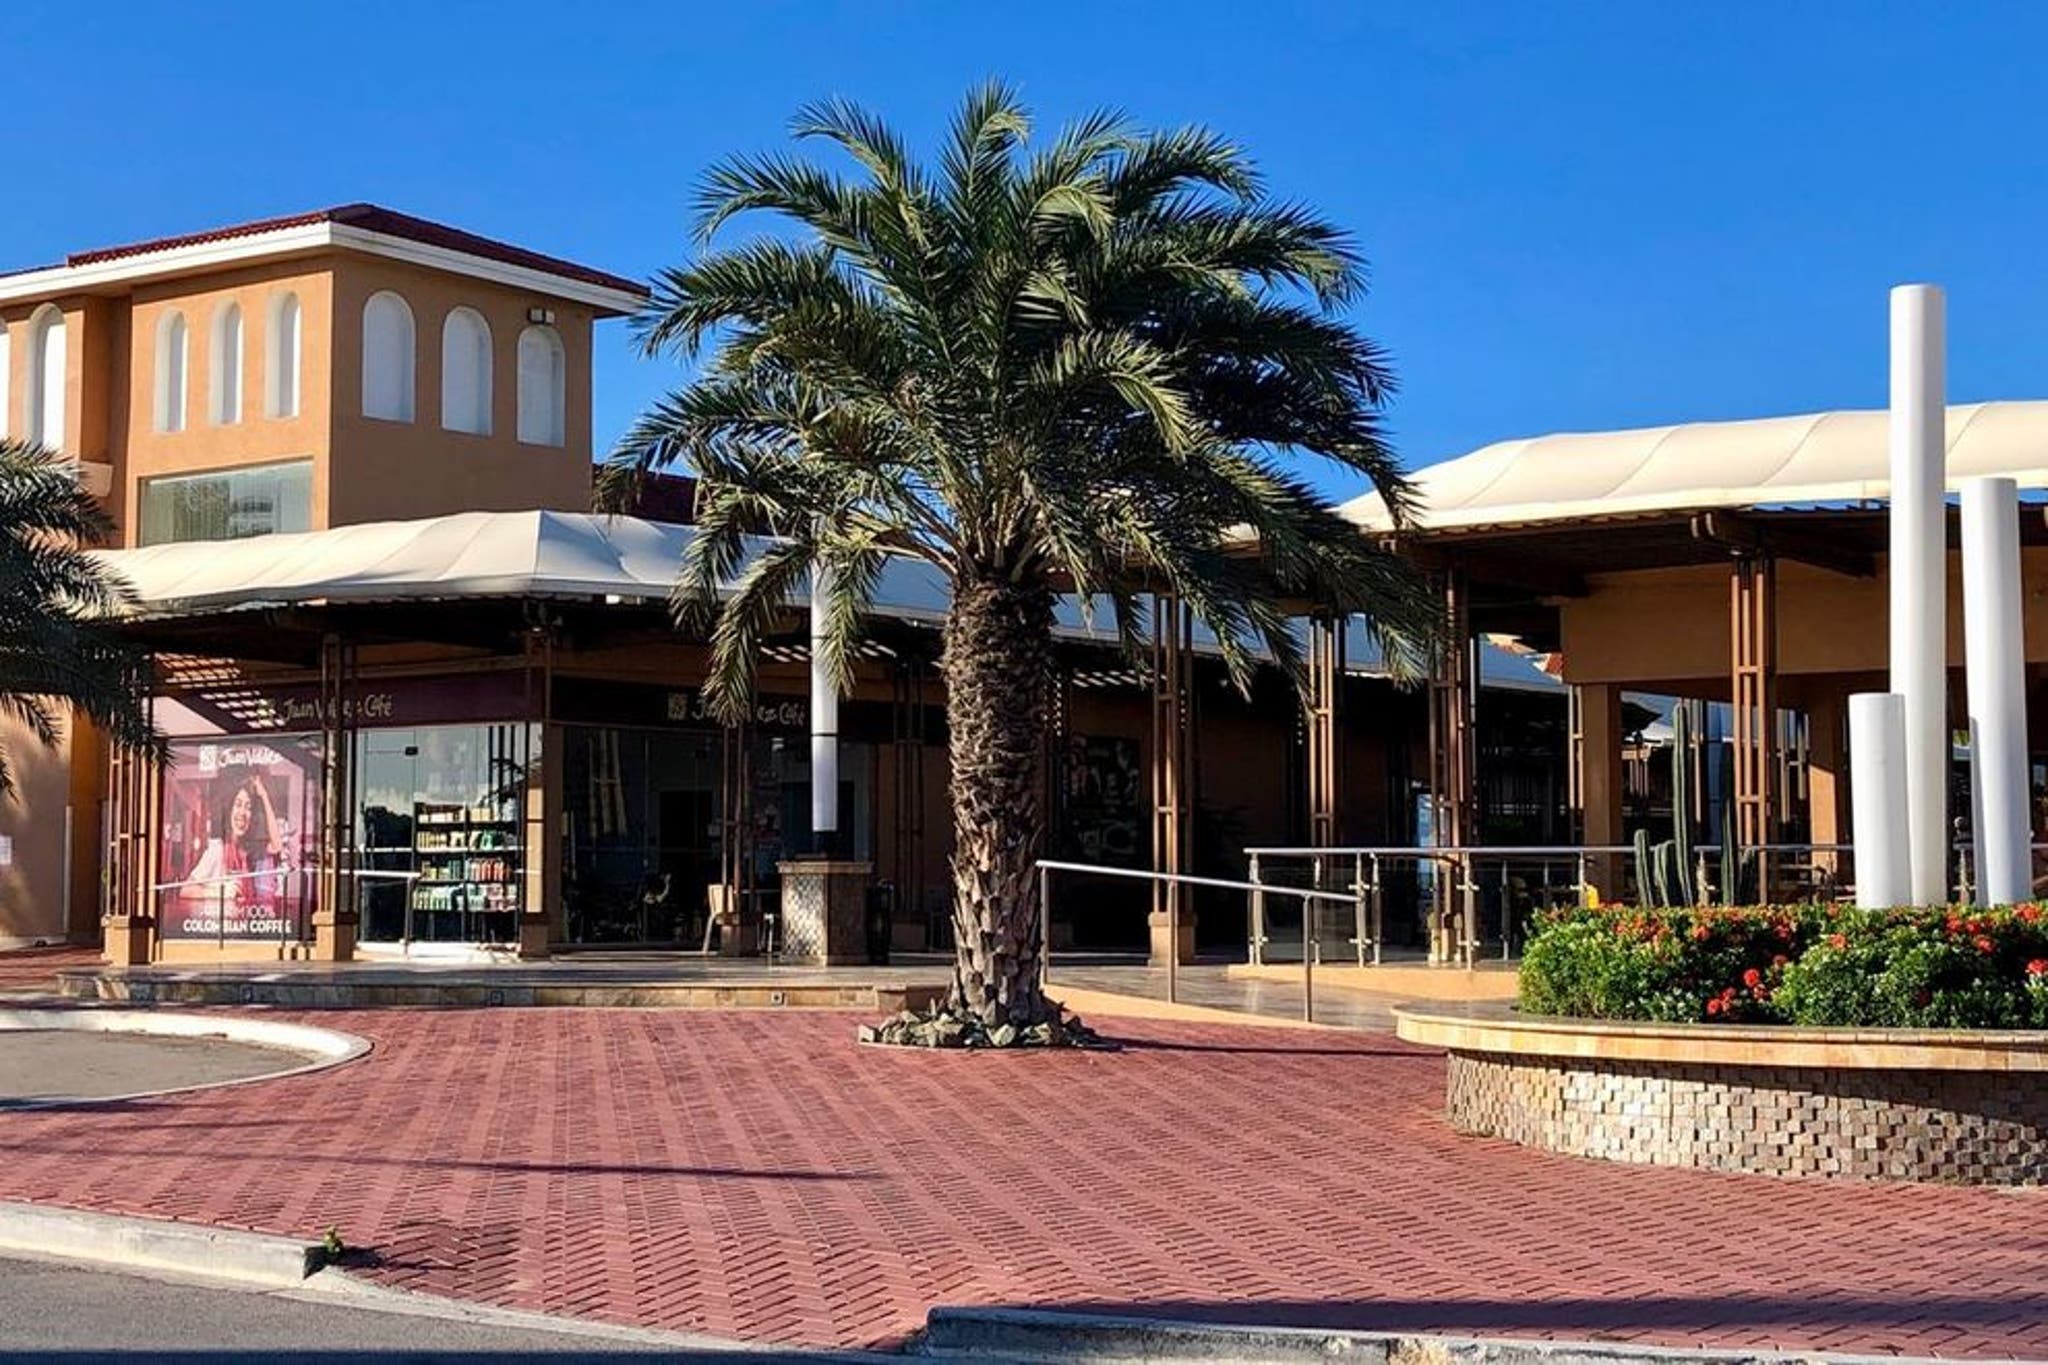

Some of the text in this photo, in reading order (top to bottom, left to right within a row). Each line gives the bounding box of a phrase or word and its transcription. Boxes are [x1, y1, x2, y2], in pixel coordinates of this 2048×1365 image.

[283, 697, 315, 721] Juan
[365, 694, 393, 718] Café
[183, 919, 292, 933] COLOMBIAN COFFEE
